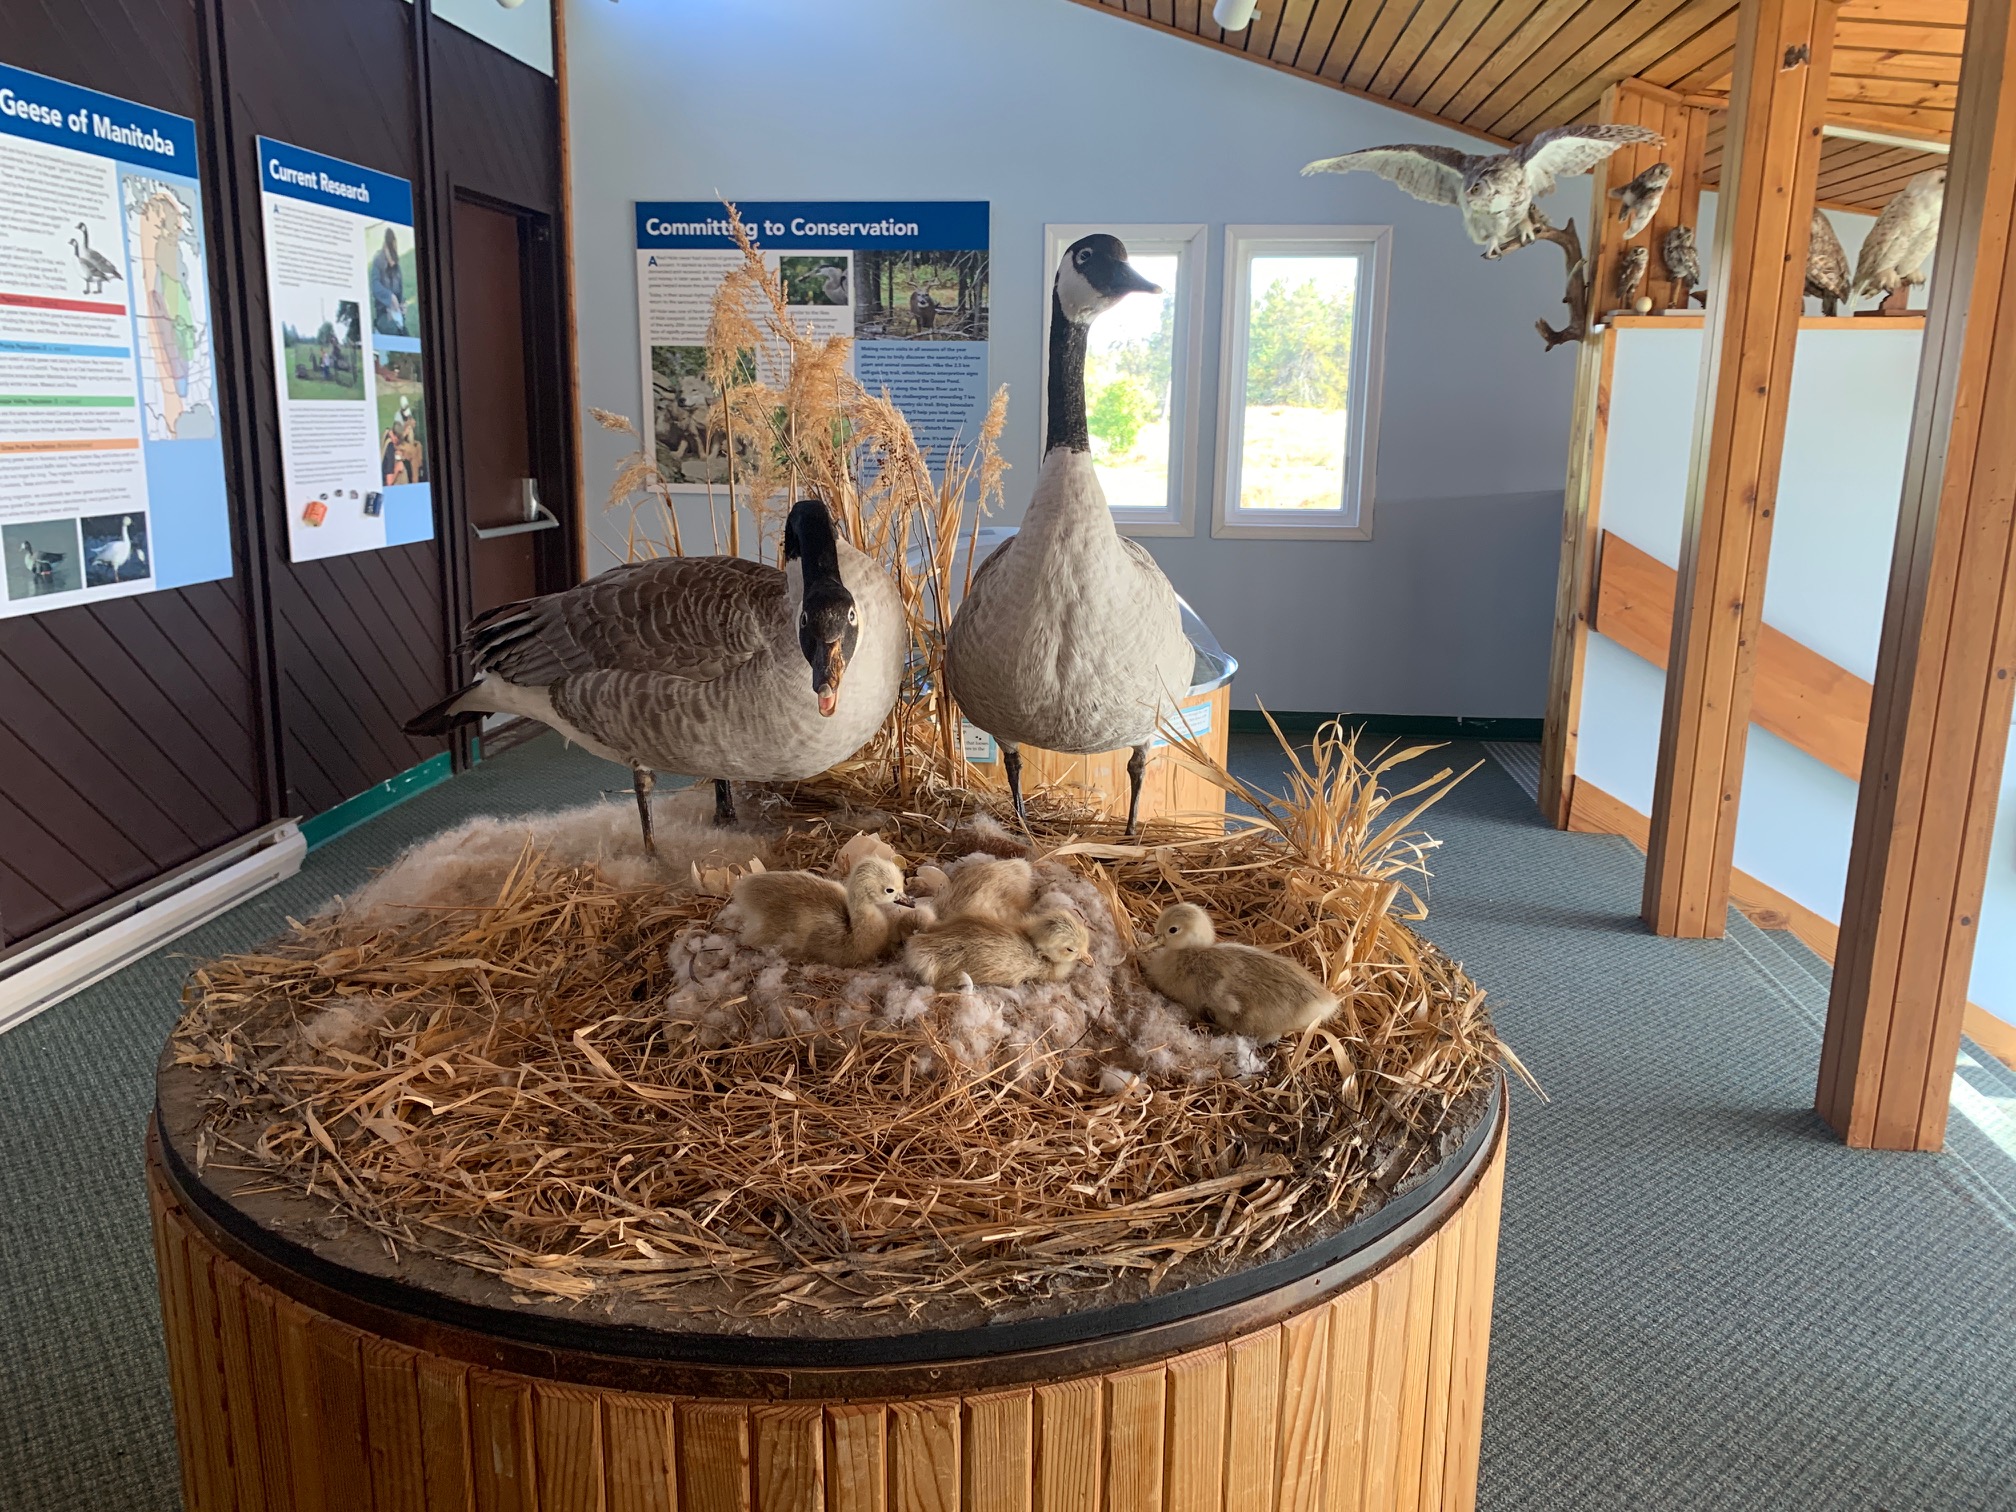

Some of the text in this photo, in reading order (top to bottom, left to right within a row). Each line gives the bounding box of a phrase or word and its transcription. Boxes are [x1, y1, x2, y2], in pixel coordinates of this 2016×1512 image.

[0, 88, 175, 156] Geese of Manitoba
[269, 158, 370, 203] Current Research
[763, 220, 785, 236] to
[790, 217, 918, 236] Conservation
